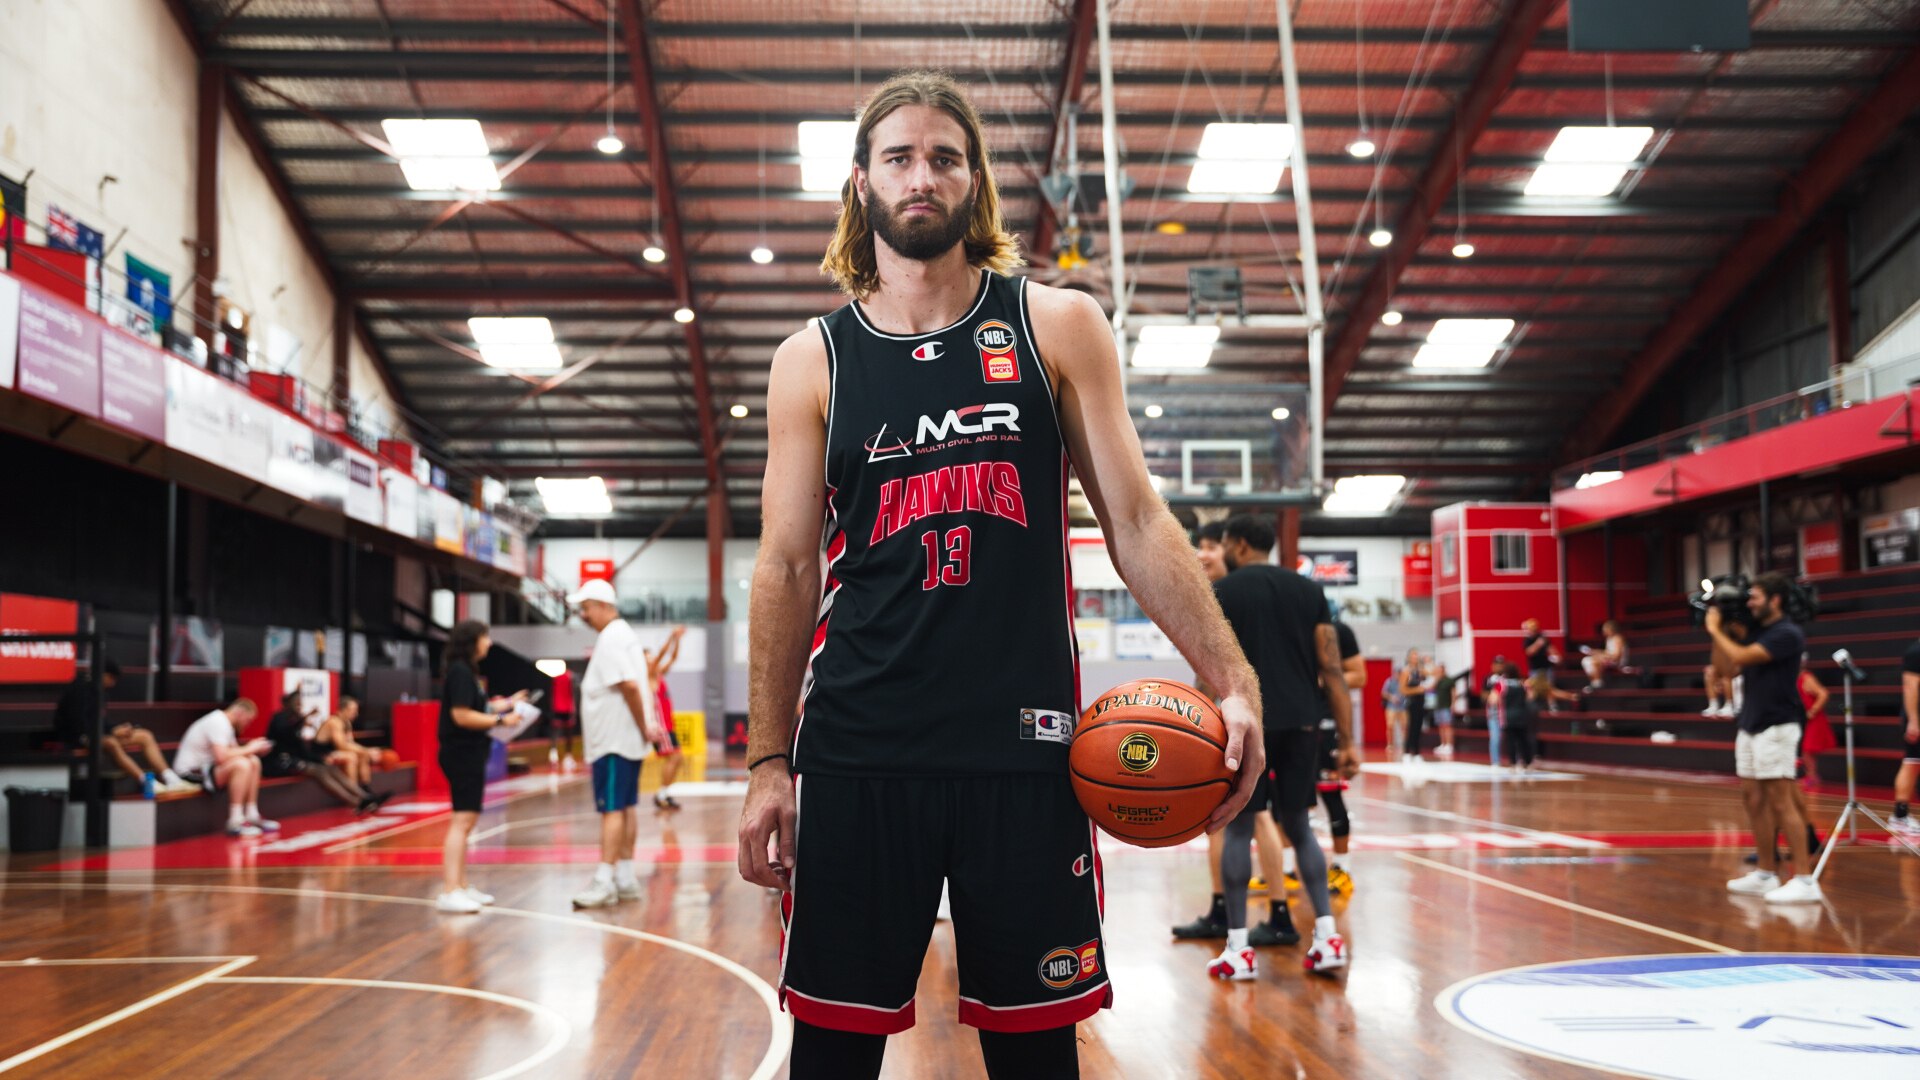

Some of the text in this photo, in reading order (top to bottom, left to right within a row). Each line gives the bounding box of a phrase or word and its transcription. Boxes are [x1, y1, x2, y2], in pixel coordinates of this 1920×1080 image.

[983, 330, 1008, 345] NBL
[915, 402, 1022, 445] MCR
[916, 434, 1022, 455] MULTI CIVIL AND RAIL
[868, 461, 1028, 548] HAWKS
[921, 525, 972, 591] 13
[1091, 692, 1204, 729] SPALDING
[1126, 743, 1149, 761] NBL
[1108, 802, 1169, 816] LEGACY
[1049, 959, 1073, 978] NBL
